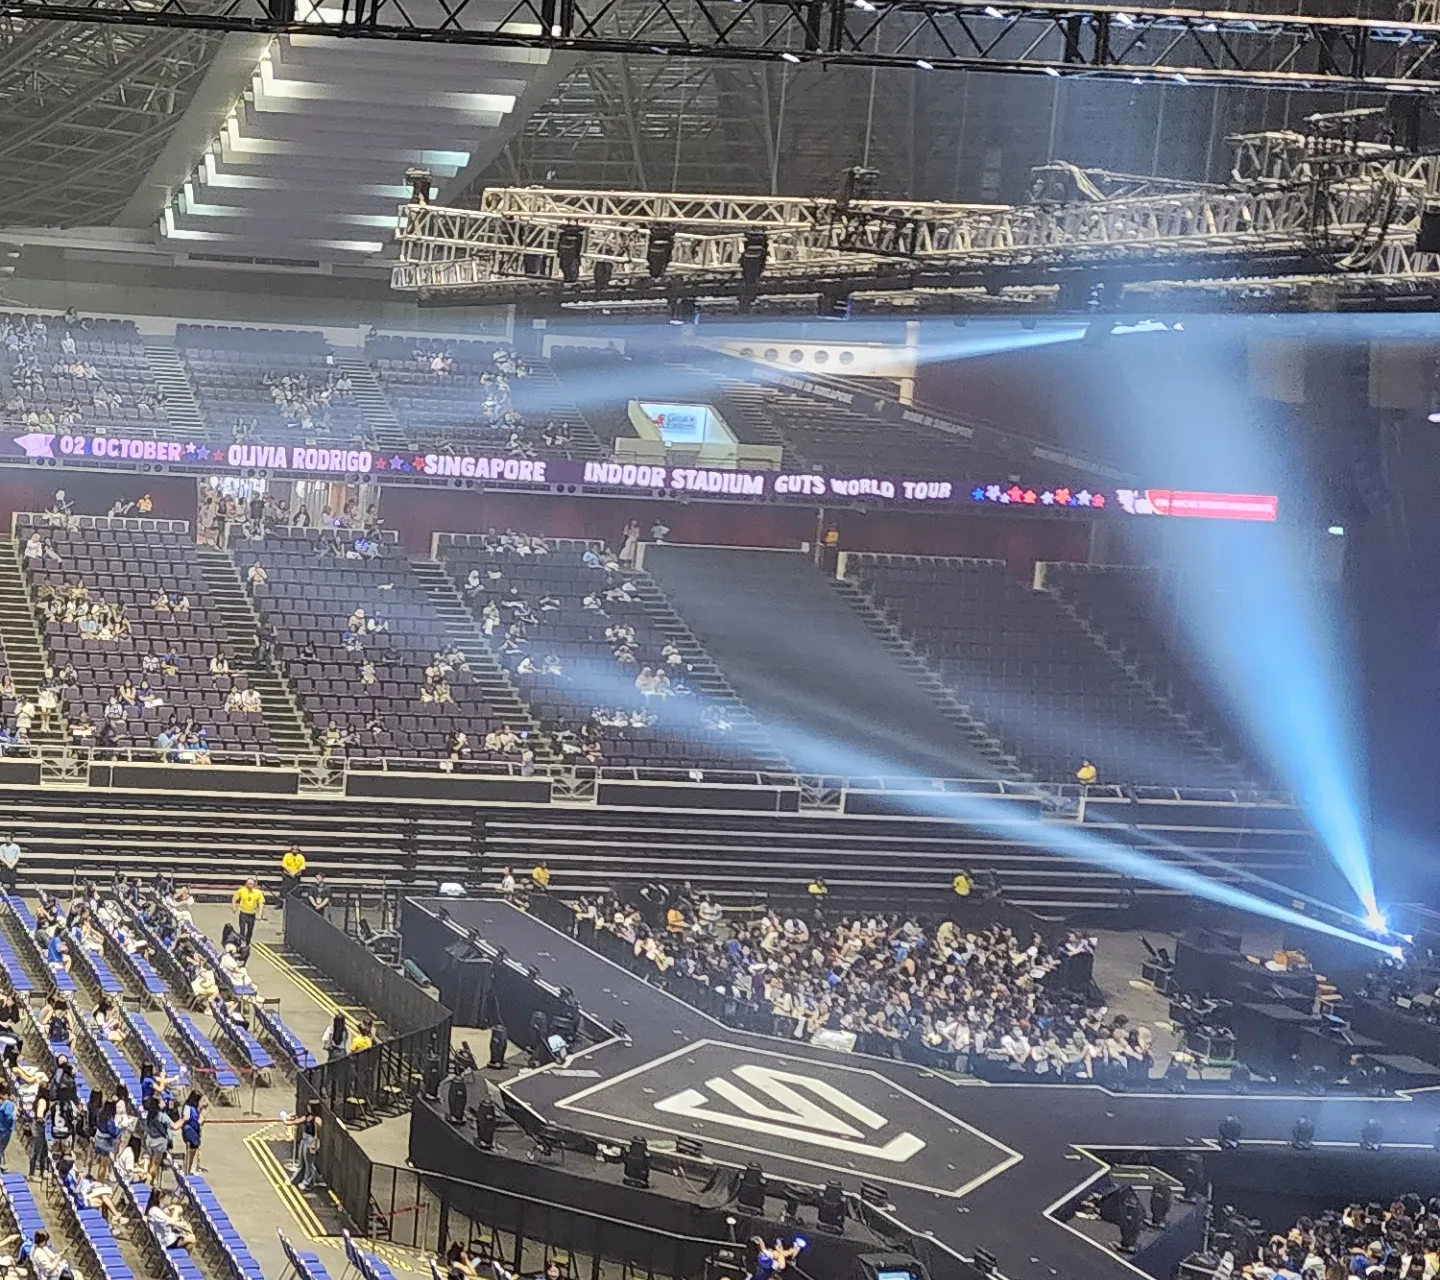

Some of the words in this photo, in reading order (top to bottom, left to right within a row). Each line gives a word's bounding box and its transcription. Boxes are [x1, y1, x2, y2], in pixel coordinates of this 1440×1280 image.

[59, 435, 86, 455] 02
[91, 437, 182, 462] OCTOBER
[228, 444, 287, 470] OLIVIA
[292, 446, 372, 473] RODRIGO
[424, 454, 546, 482] SINGAPORE
[584, 461, 666, 489] INDOOR
[671, 467, 764, 496] STADIUM
[774, 474, 826, 496] GUTS
[830, 477, 895, 499] WORLD
[903, 481, 951, 501] TOUR
